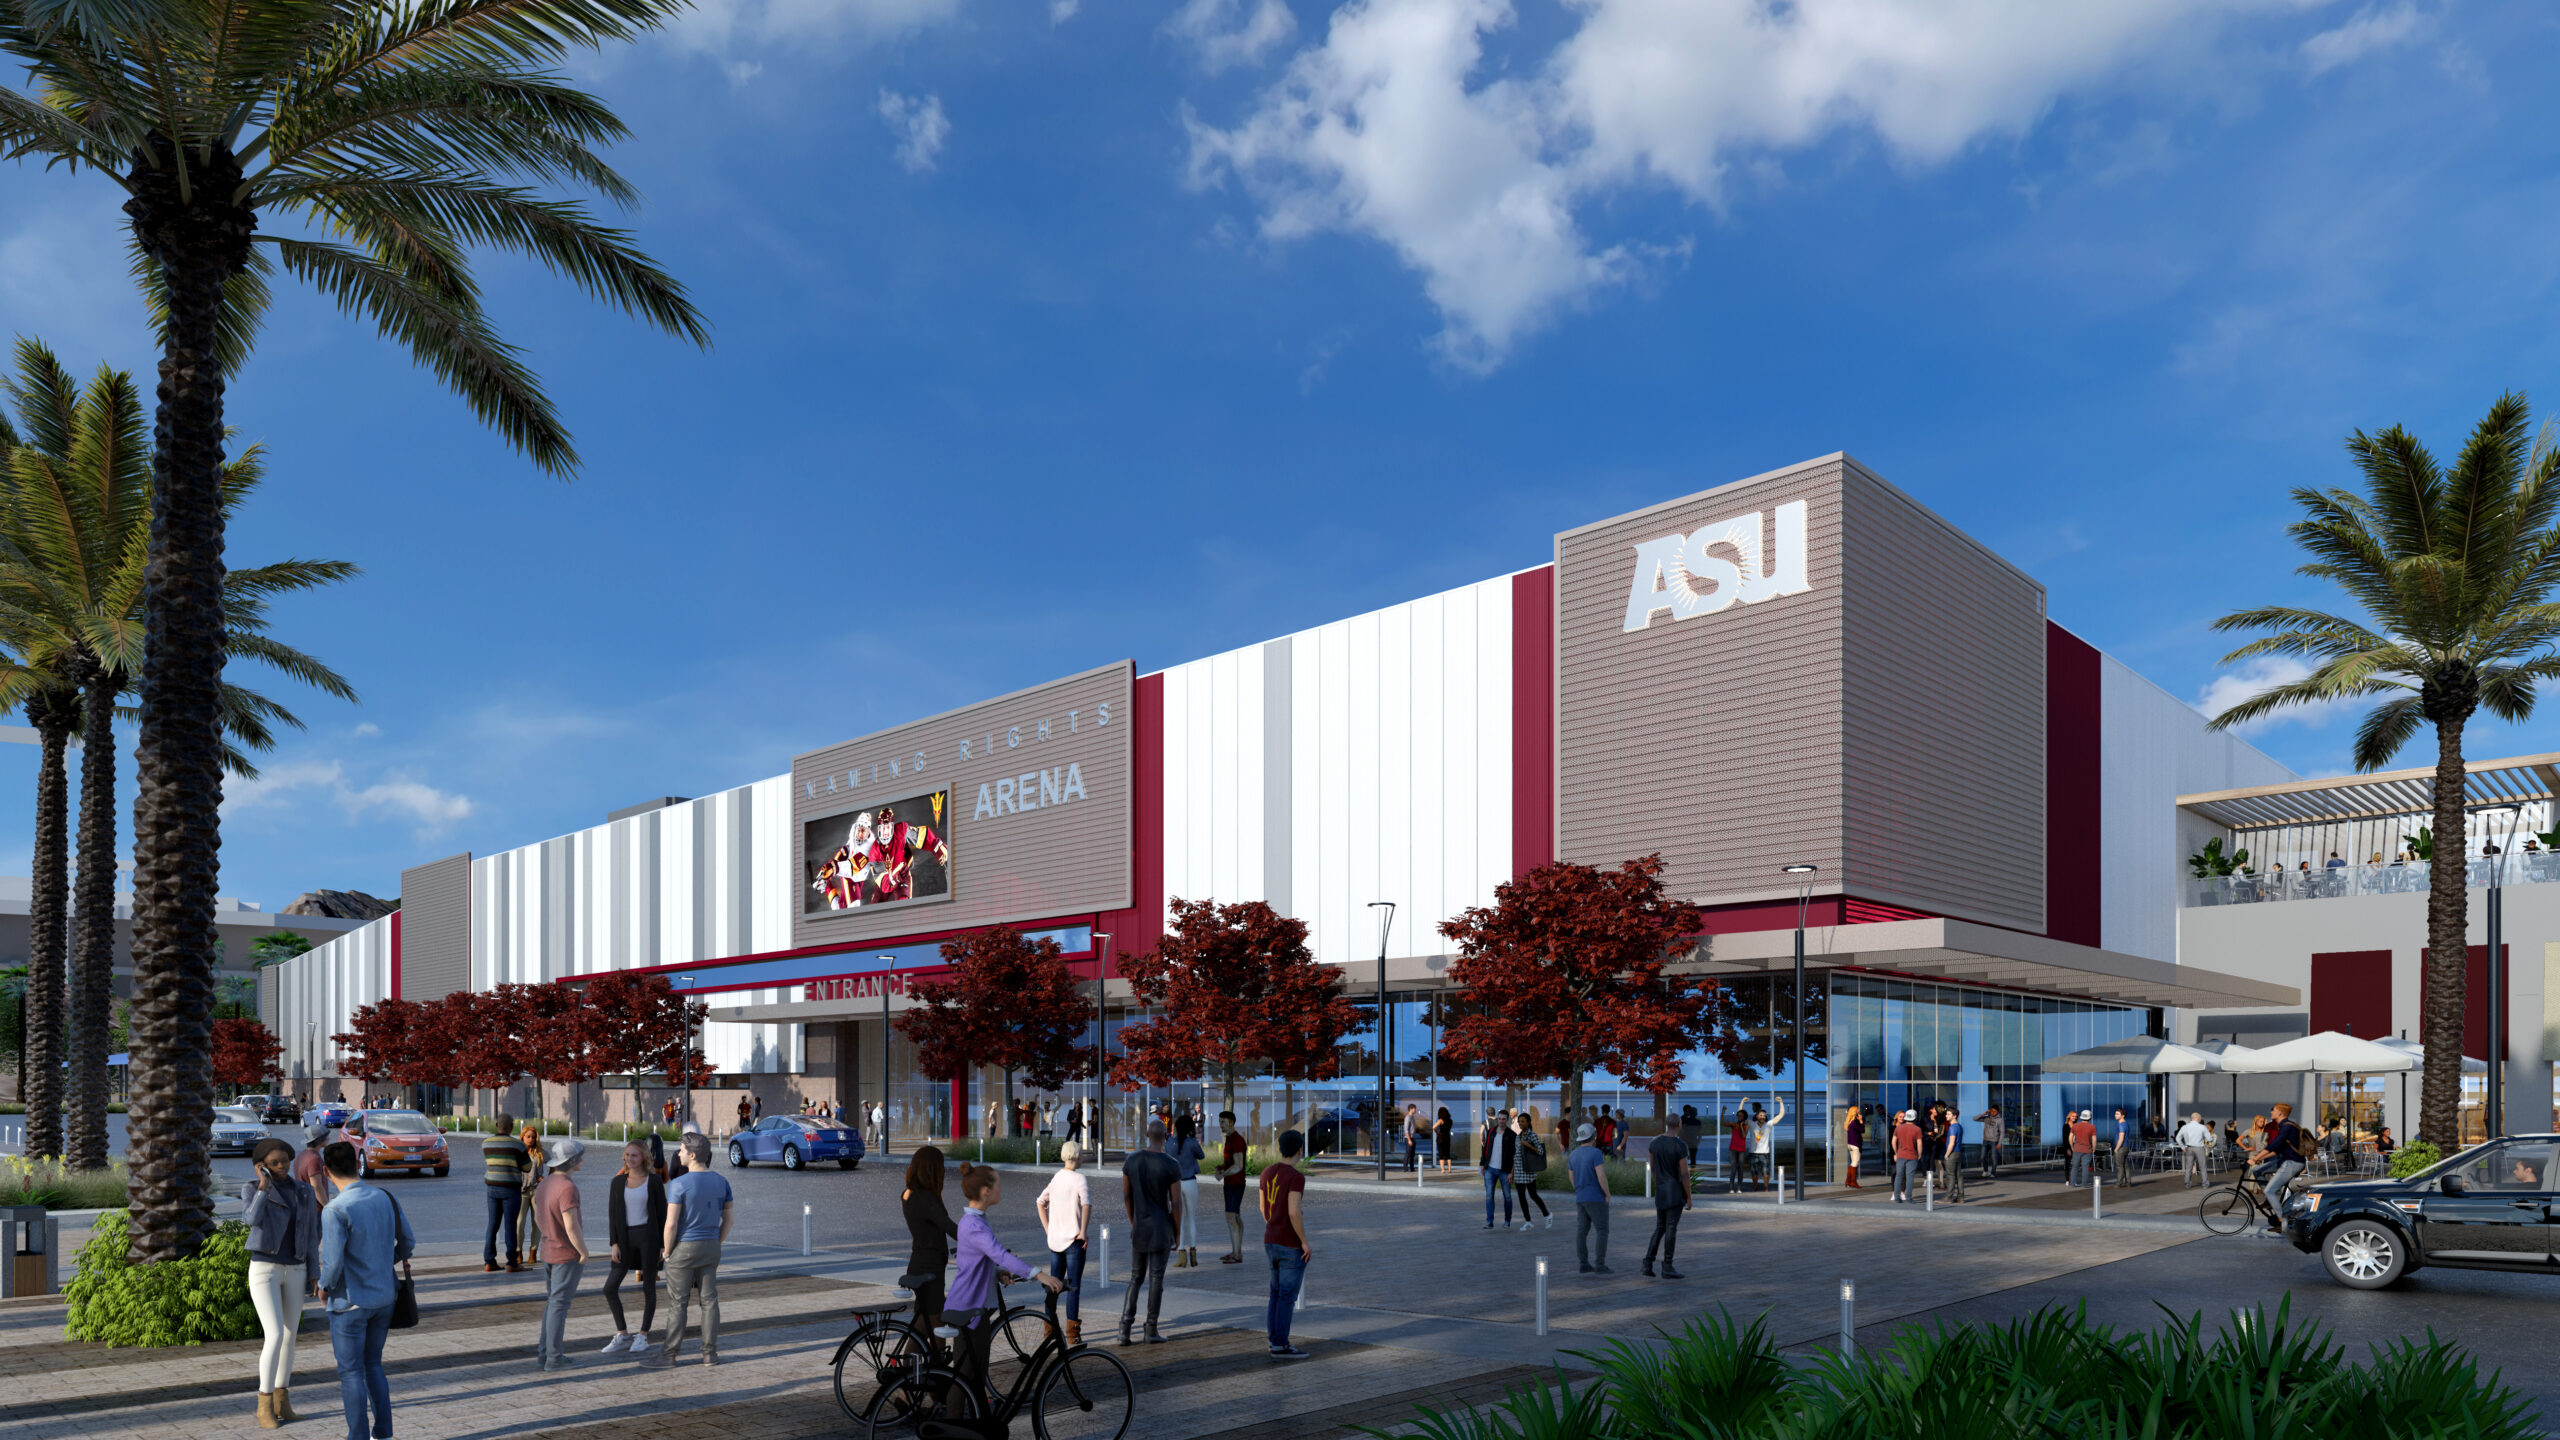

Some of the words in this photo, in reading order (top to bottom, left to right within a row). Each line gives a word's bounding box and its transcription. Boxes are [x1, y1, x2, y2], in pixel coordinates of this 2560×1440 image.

[1622, 499, 1812, 633] ASU
[804, 751, 926, 801] NAMING
[960, 702, 1112, 761] RIGHTS
[972, 762, 1088, 821] ARENA
[803, 972, 915, 1002] ENTRANCE
